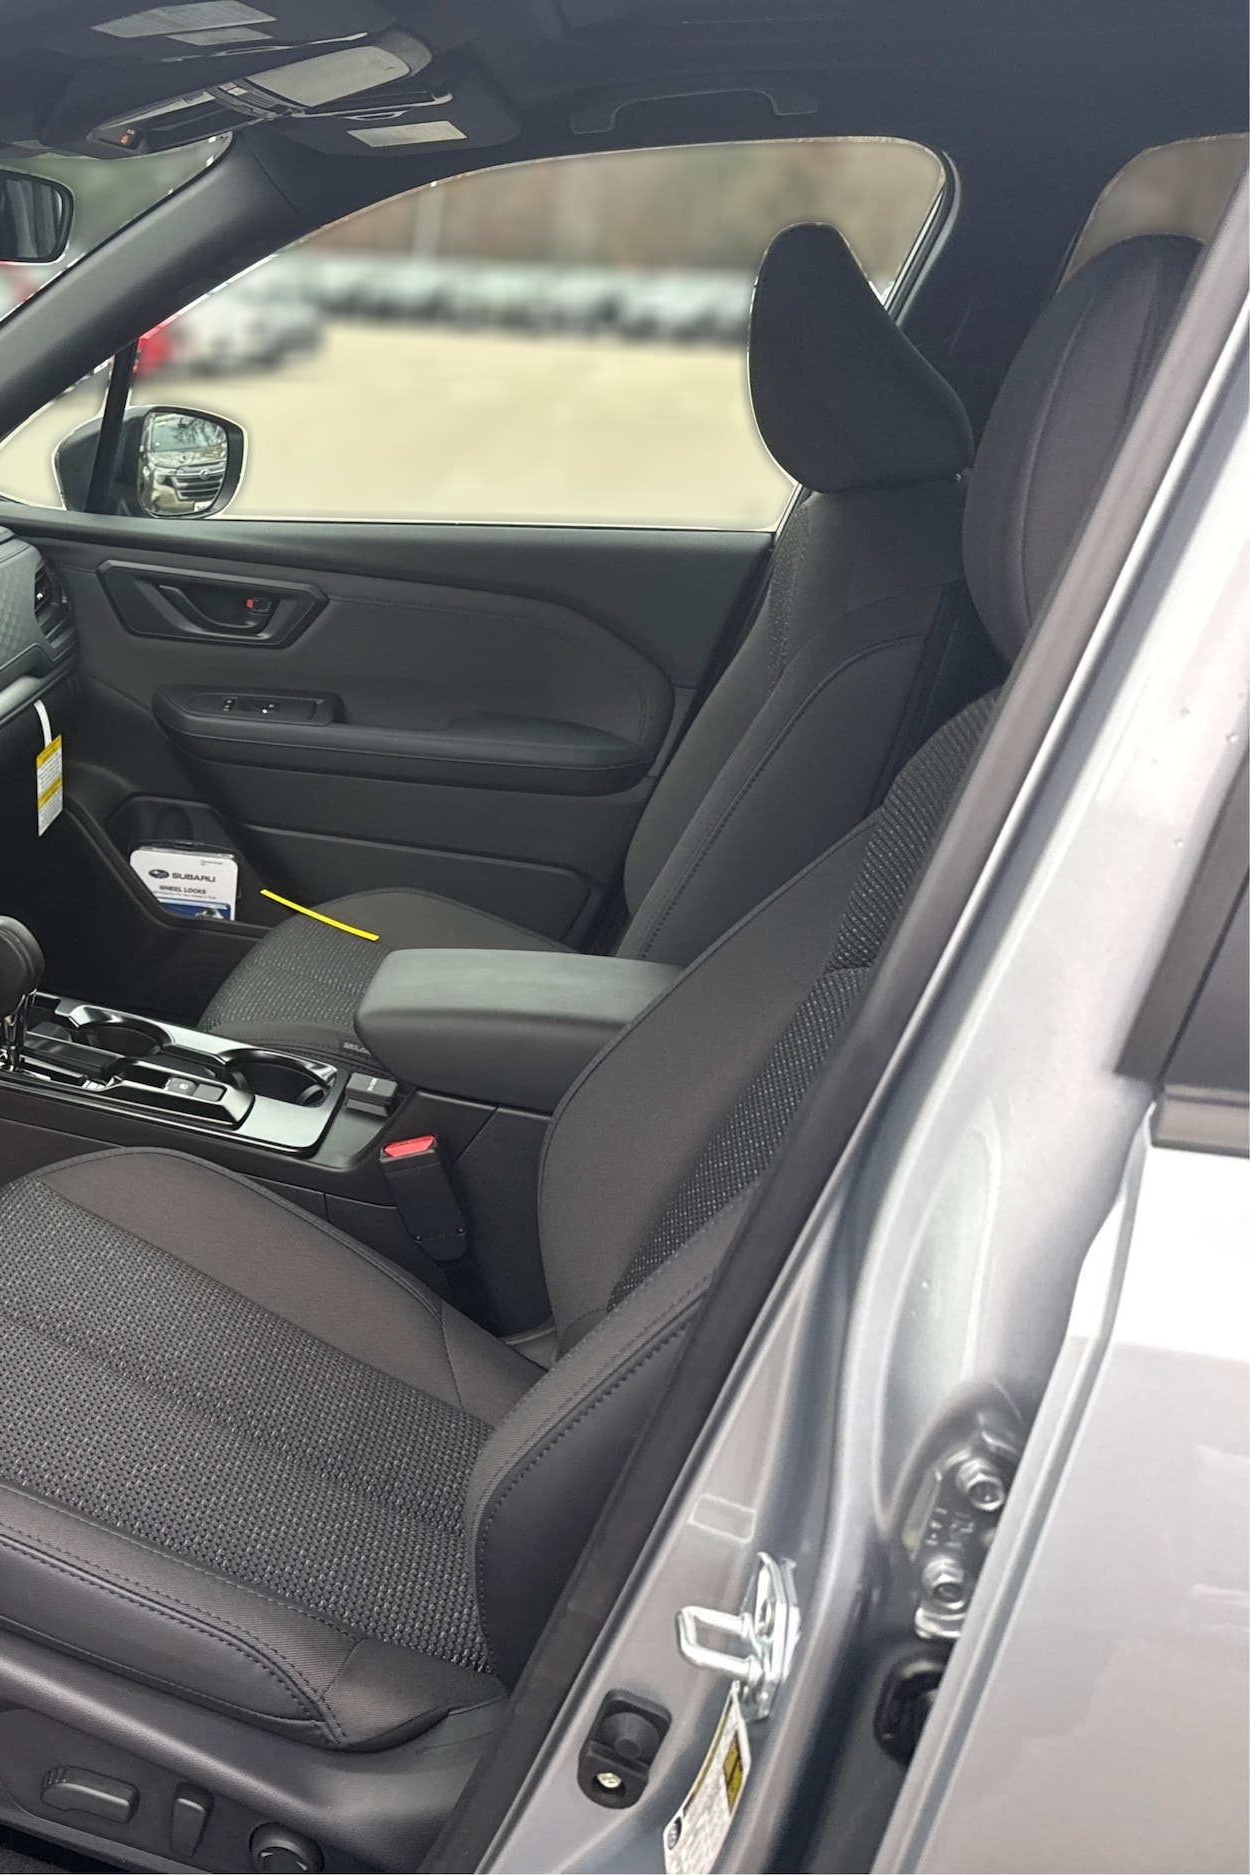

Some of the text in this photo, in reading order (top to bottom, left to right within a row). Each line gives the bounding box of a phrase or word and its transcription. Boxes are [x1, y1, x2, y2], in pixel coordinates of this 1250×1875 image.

[172, 872, 216, 883] SUBARU
[159, 885, 182, 893] WHEEL
[184, 887, 206, 895] LOCKS
